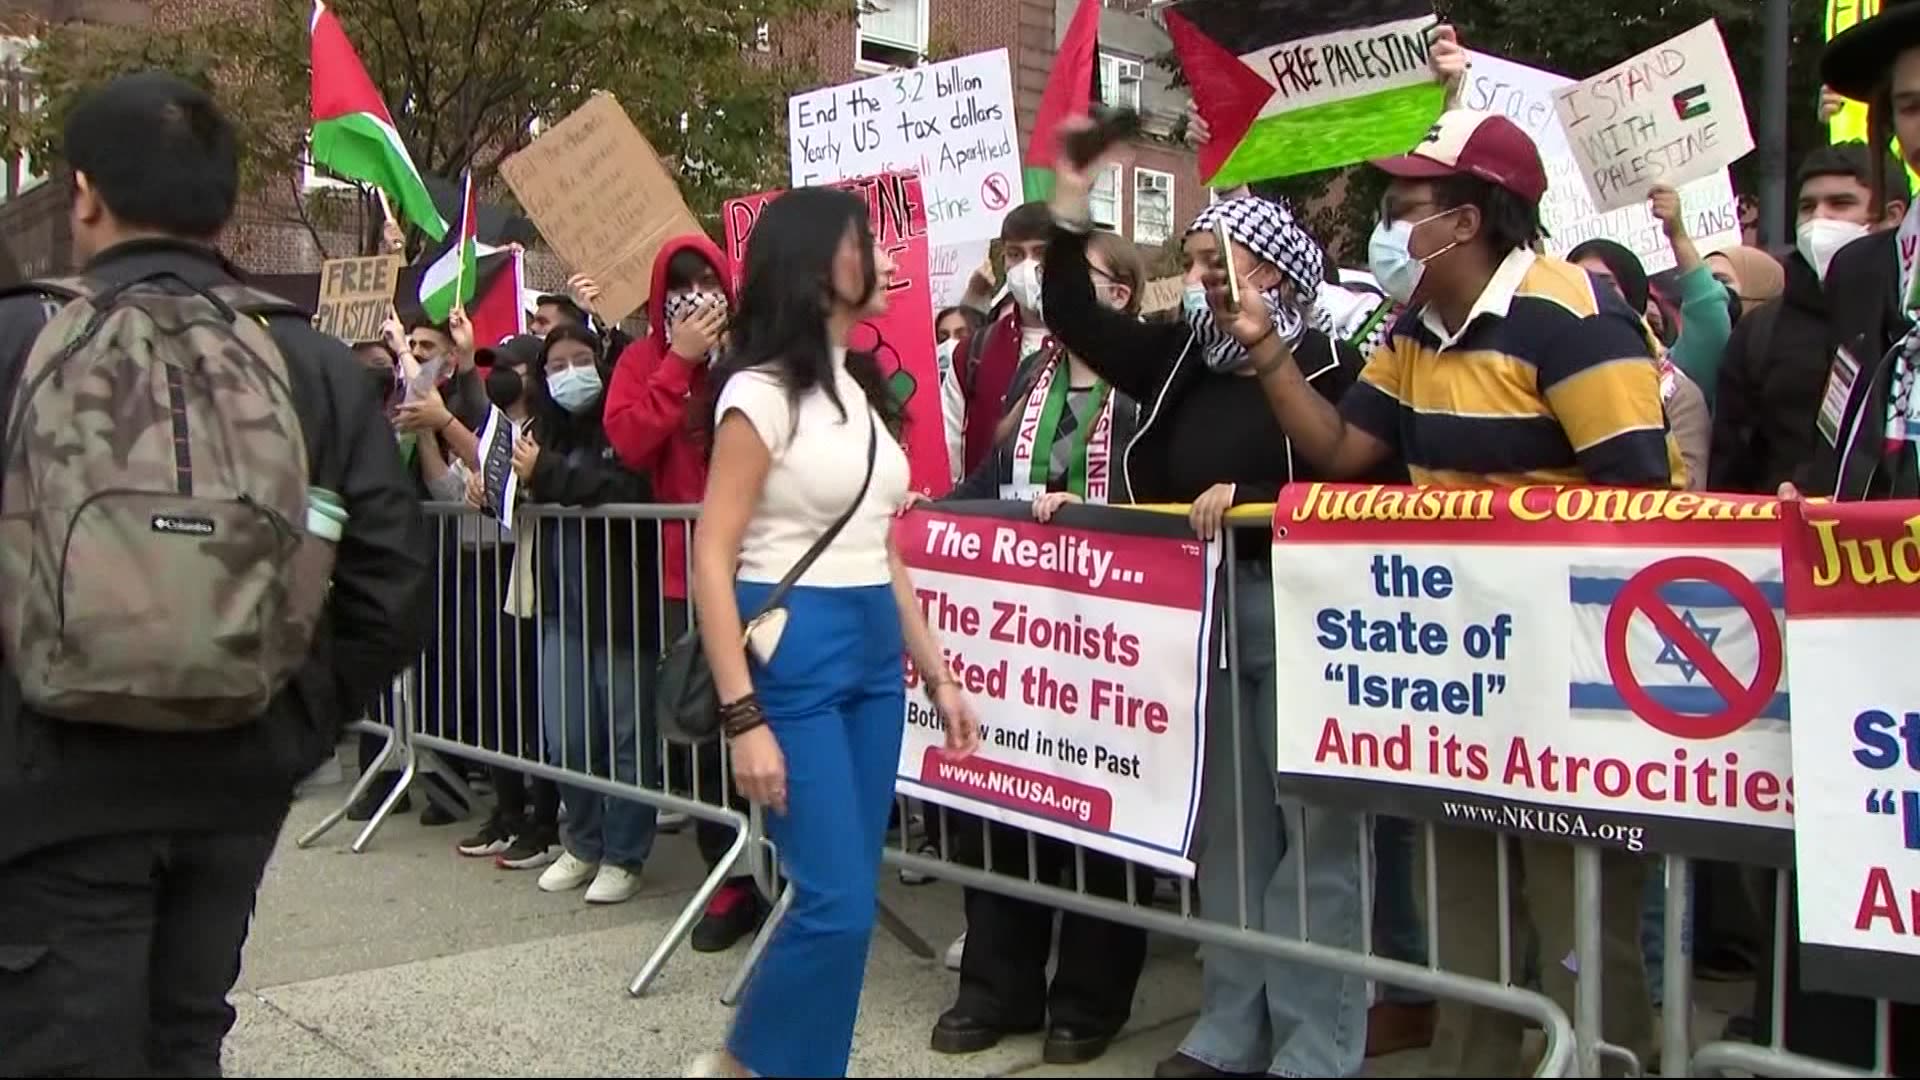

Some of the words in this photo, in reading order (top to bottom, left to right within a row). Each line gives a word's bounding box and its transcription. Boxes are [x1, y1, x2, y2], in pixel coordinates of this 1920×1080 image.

[798, 93, 838, 129] End
[846, 87, 881, 118] the
[894, 72, 925, 105] 3.2
[936, 66, 982, 99] billion
[1269, 43, 1322, 98] FREE
[1559, 89, 1591, 128] I
[1590, 48, 1687, 121] STAND
[797, 130, 841, 166] Yearly
[852, 119, 881, 153] US
[897, 112, 941, 143] tax
[949, 96, 1004, 130] dollars
[1467, 75, 1555, 146] srael
[939, 133, 1012, 173] Apartheid
[1577, 112, 1658, 167] WITH
[1592, 121, 1719, 202] PALESTINE
[927, 186, 972, 222] stine
[327, 259, 389, 296] FREE
[1292, 483, 1495, 521] Judaism
[925, 519, 981, 560] The
[991, 527, 1145, 588] Reality...
[1371, 555, 1454, 599] the
[915, 588, 980, 637] The
[989, 600, 1141, 668] Zionists
[1316, 607, 1448, 656] State
[1462, 613, 1512, 661] of
[1020, 665, 1079, 715] the
[1090, 679, 1169, 734] Fire
[994, 726, 1029, 752] and
[1036, 730, 1053, 757] in
[1058, 738, 1088, 766] the
[1094, 746, 1141, 779] Past
[1314, 717, 1412, 773] And
[1428, 725, 1490, 783] its
[939, 762, 1092, 822] www.NKUSA.org
[1443, 799, 1644, 853] www.NKUSA.org
